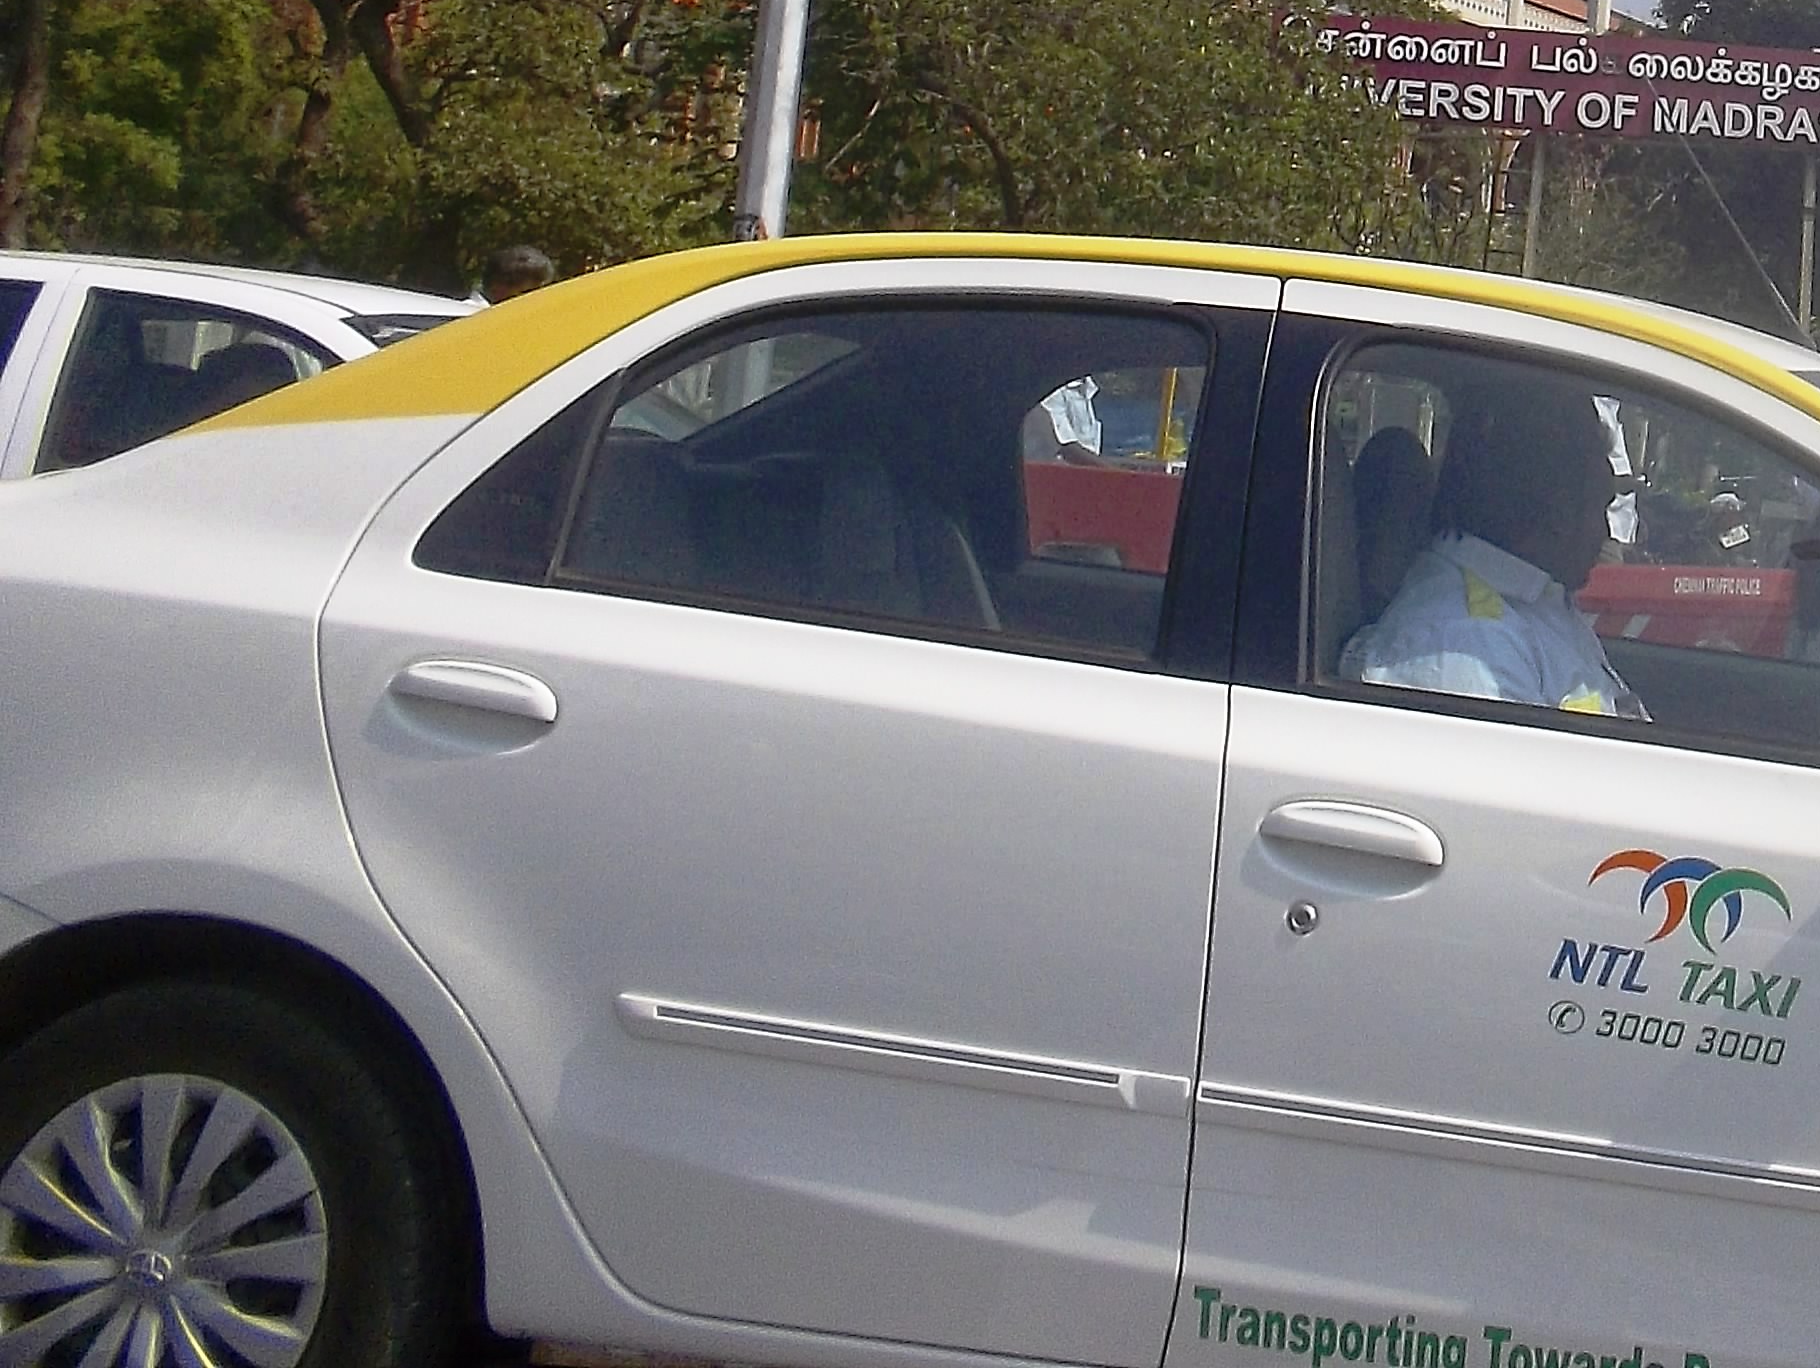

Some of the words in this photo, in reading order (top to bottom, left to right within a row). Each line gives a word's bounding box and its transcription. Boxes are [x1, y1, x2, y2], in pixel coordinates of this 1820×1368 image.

[1340, 74, 1566, 126] VERSITY
[1576, 91, 1640, 130] OF
[1549, 938, 1649, 994] NTL
[1679, 959, 1802, 1020] TAXI
[1595, 1008, 1686, 1050] 3000
[1696, 1026, 1787, 1066] 3000
[1193, 1285, 1468, 1368] Transporting
